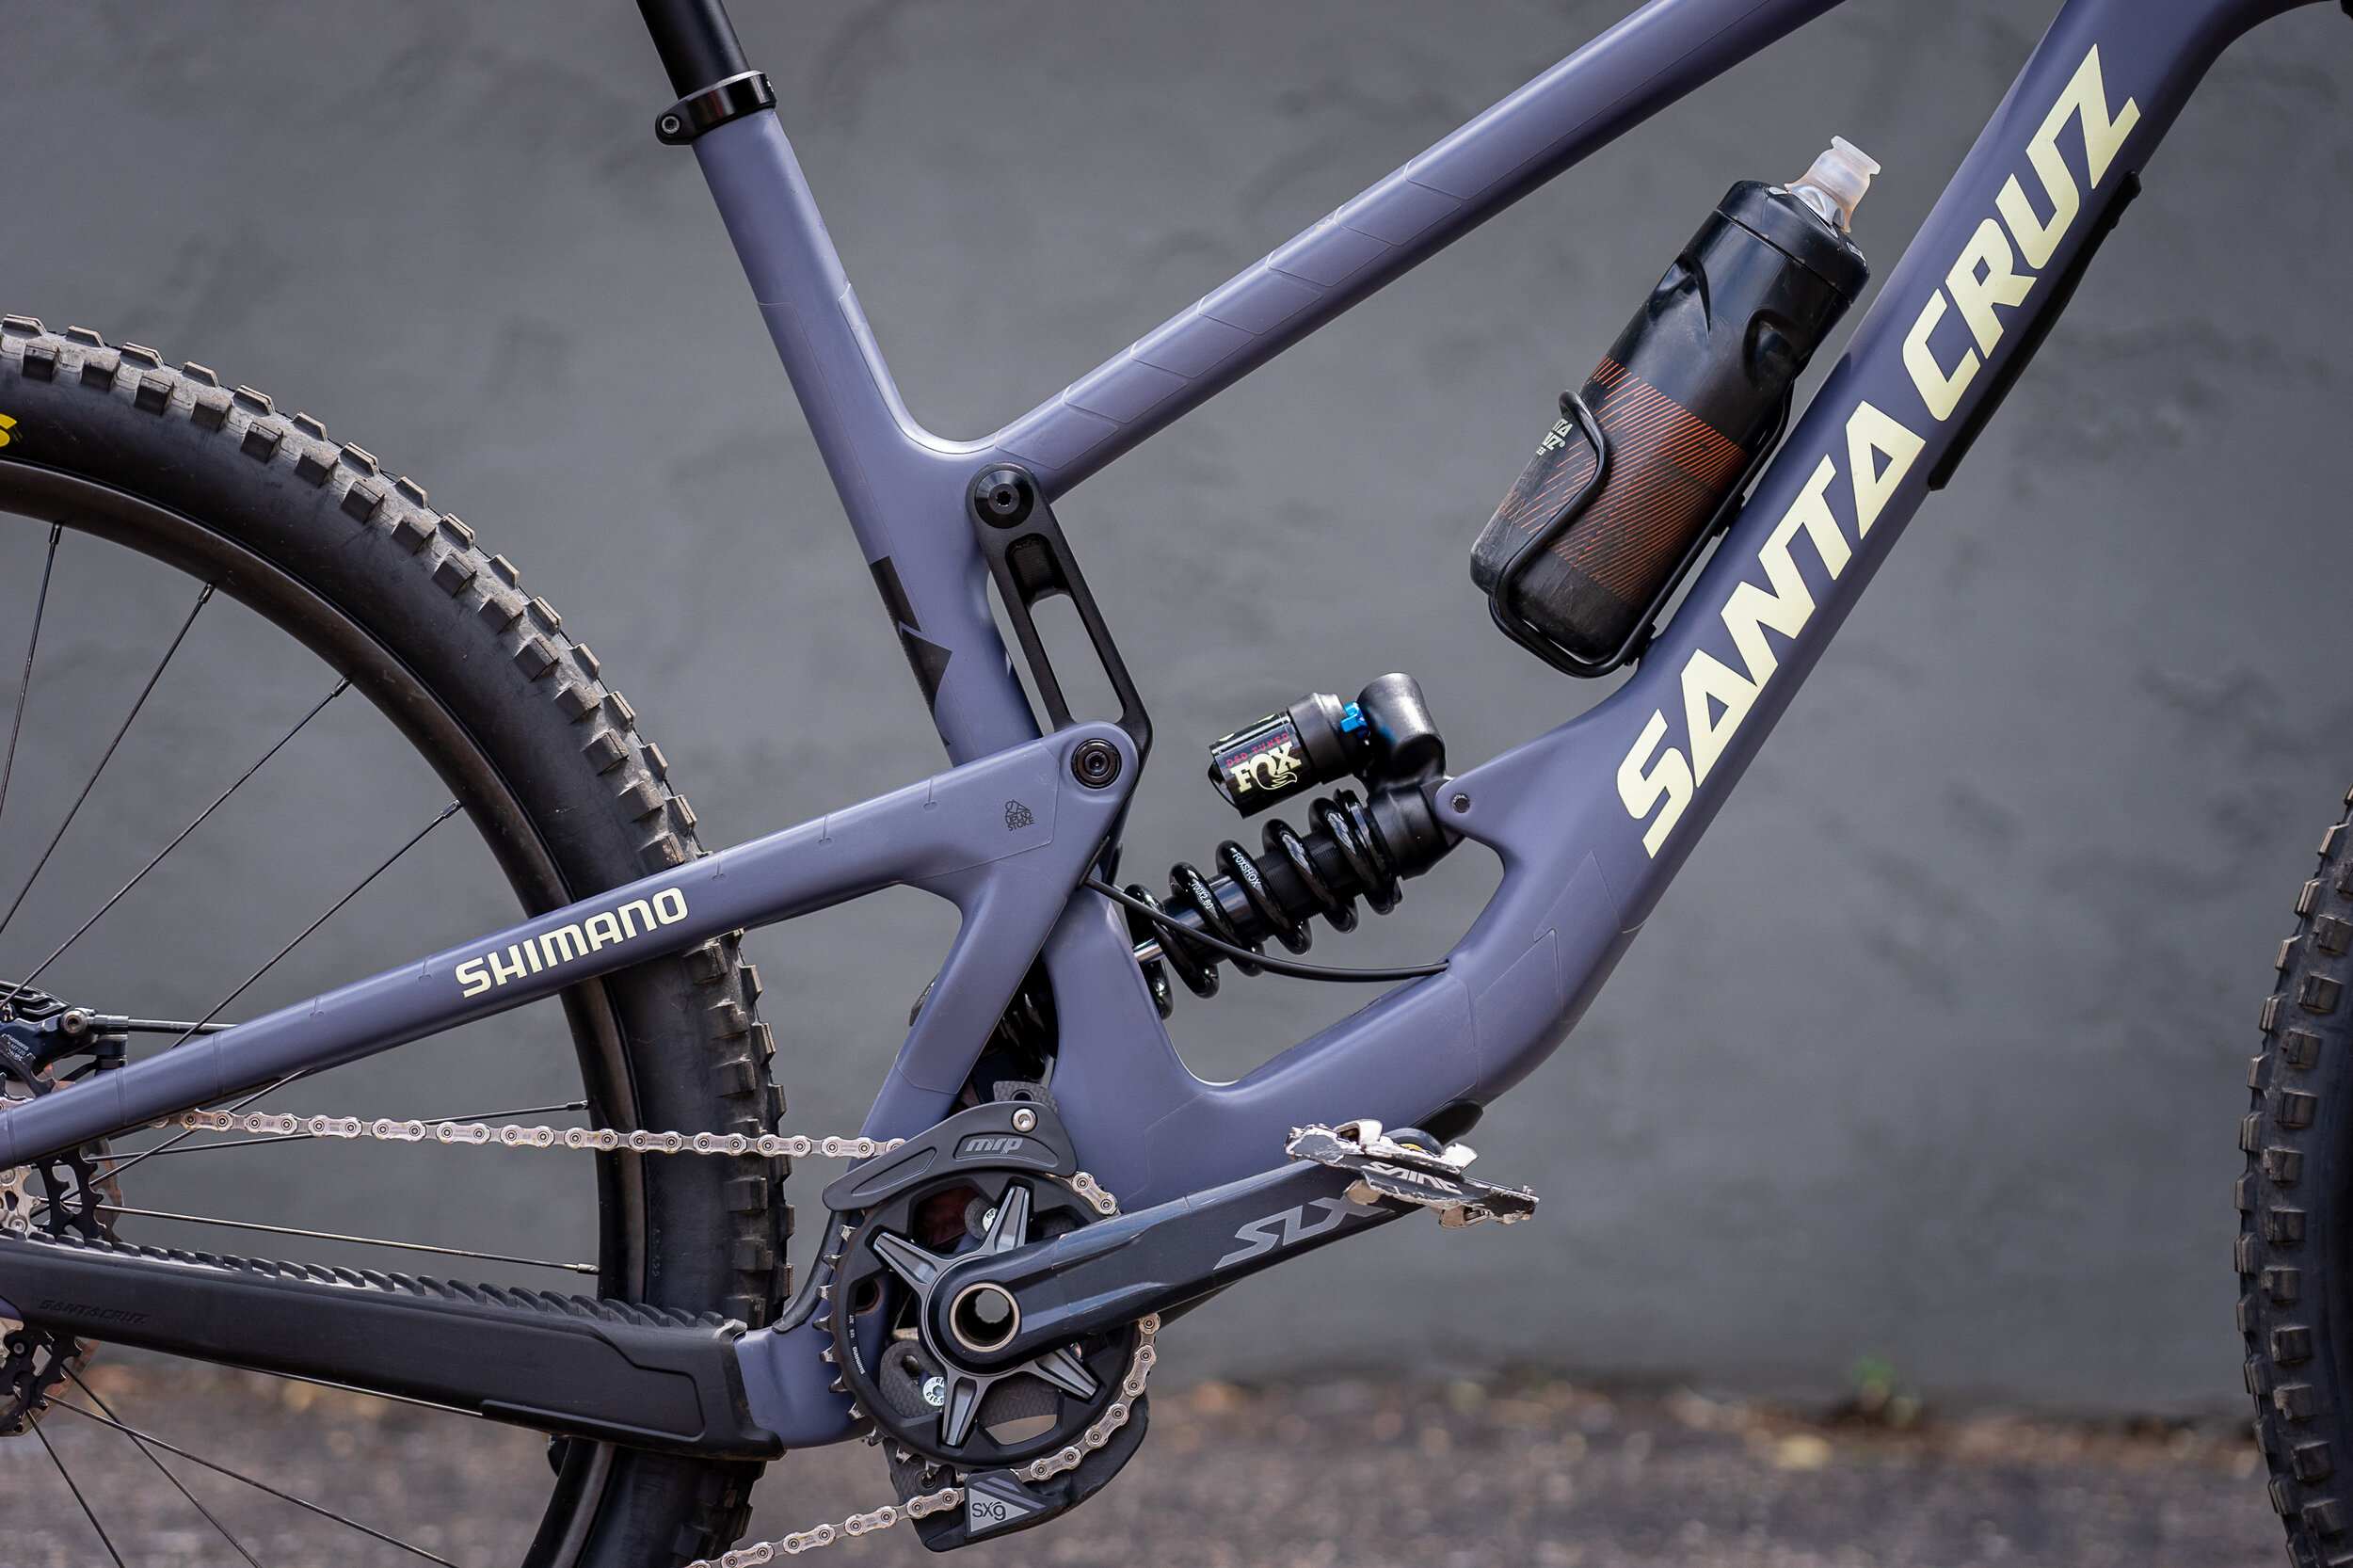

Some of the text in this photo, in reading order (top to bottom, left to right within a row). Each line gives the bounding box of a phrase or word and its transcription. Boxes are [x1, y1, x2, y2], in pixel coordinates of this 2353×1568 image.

[1617, 43, 2141, 859] SANTA CRUZ
[1225, 732, 1289, 767] DSD TUNED
[1229, 741, 1303, 792] FOX
[1007, 817, 1035, 832] STOKE
[1232, 852, 1261, 888] FOXSHOX
[455, 888, 688, 998] SHIMANO
[1361, 1160, 1464, 1195] SAINT
[1213, 1196, 1388, 1271] SLX
[852, 1346, 866, 1375] SHIMANO
